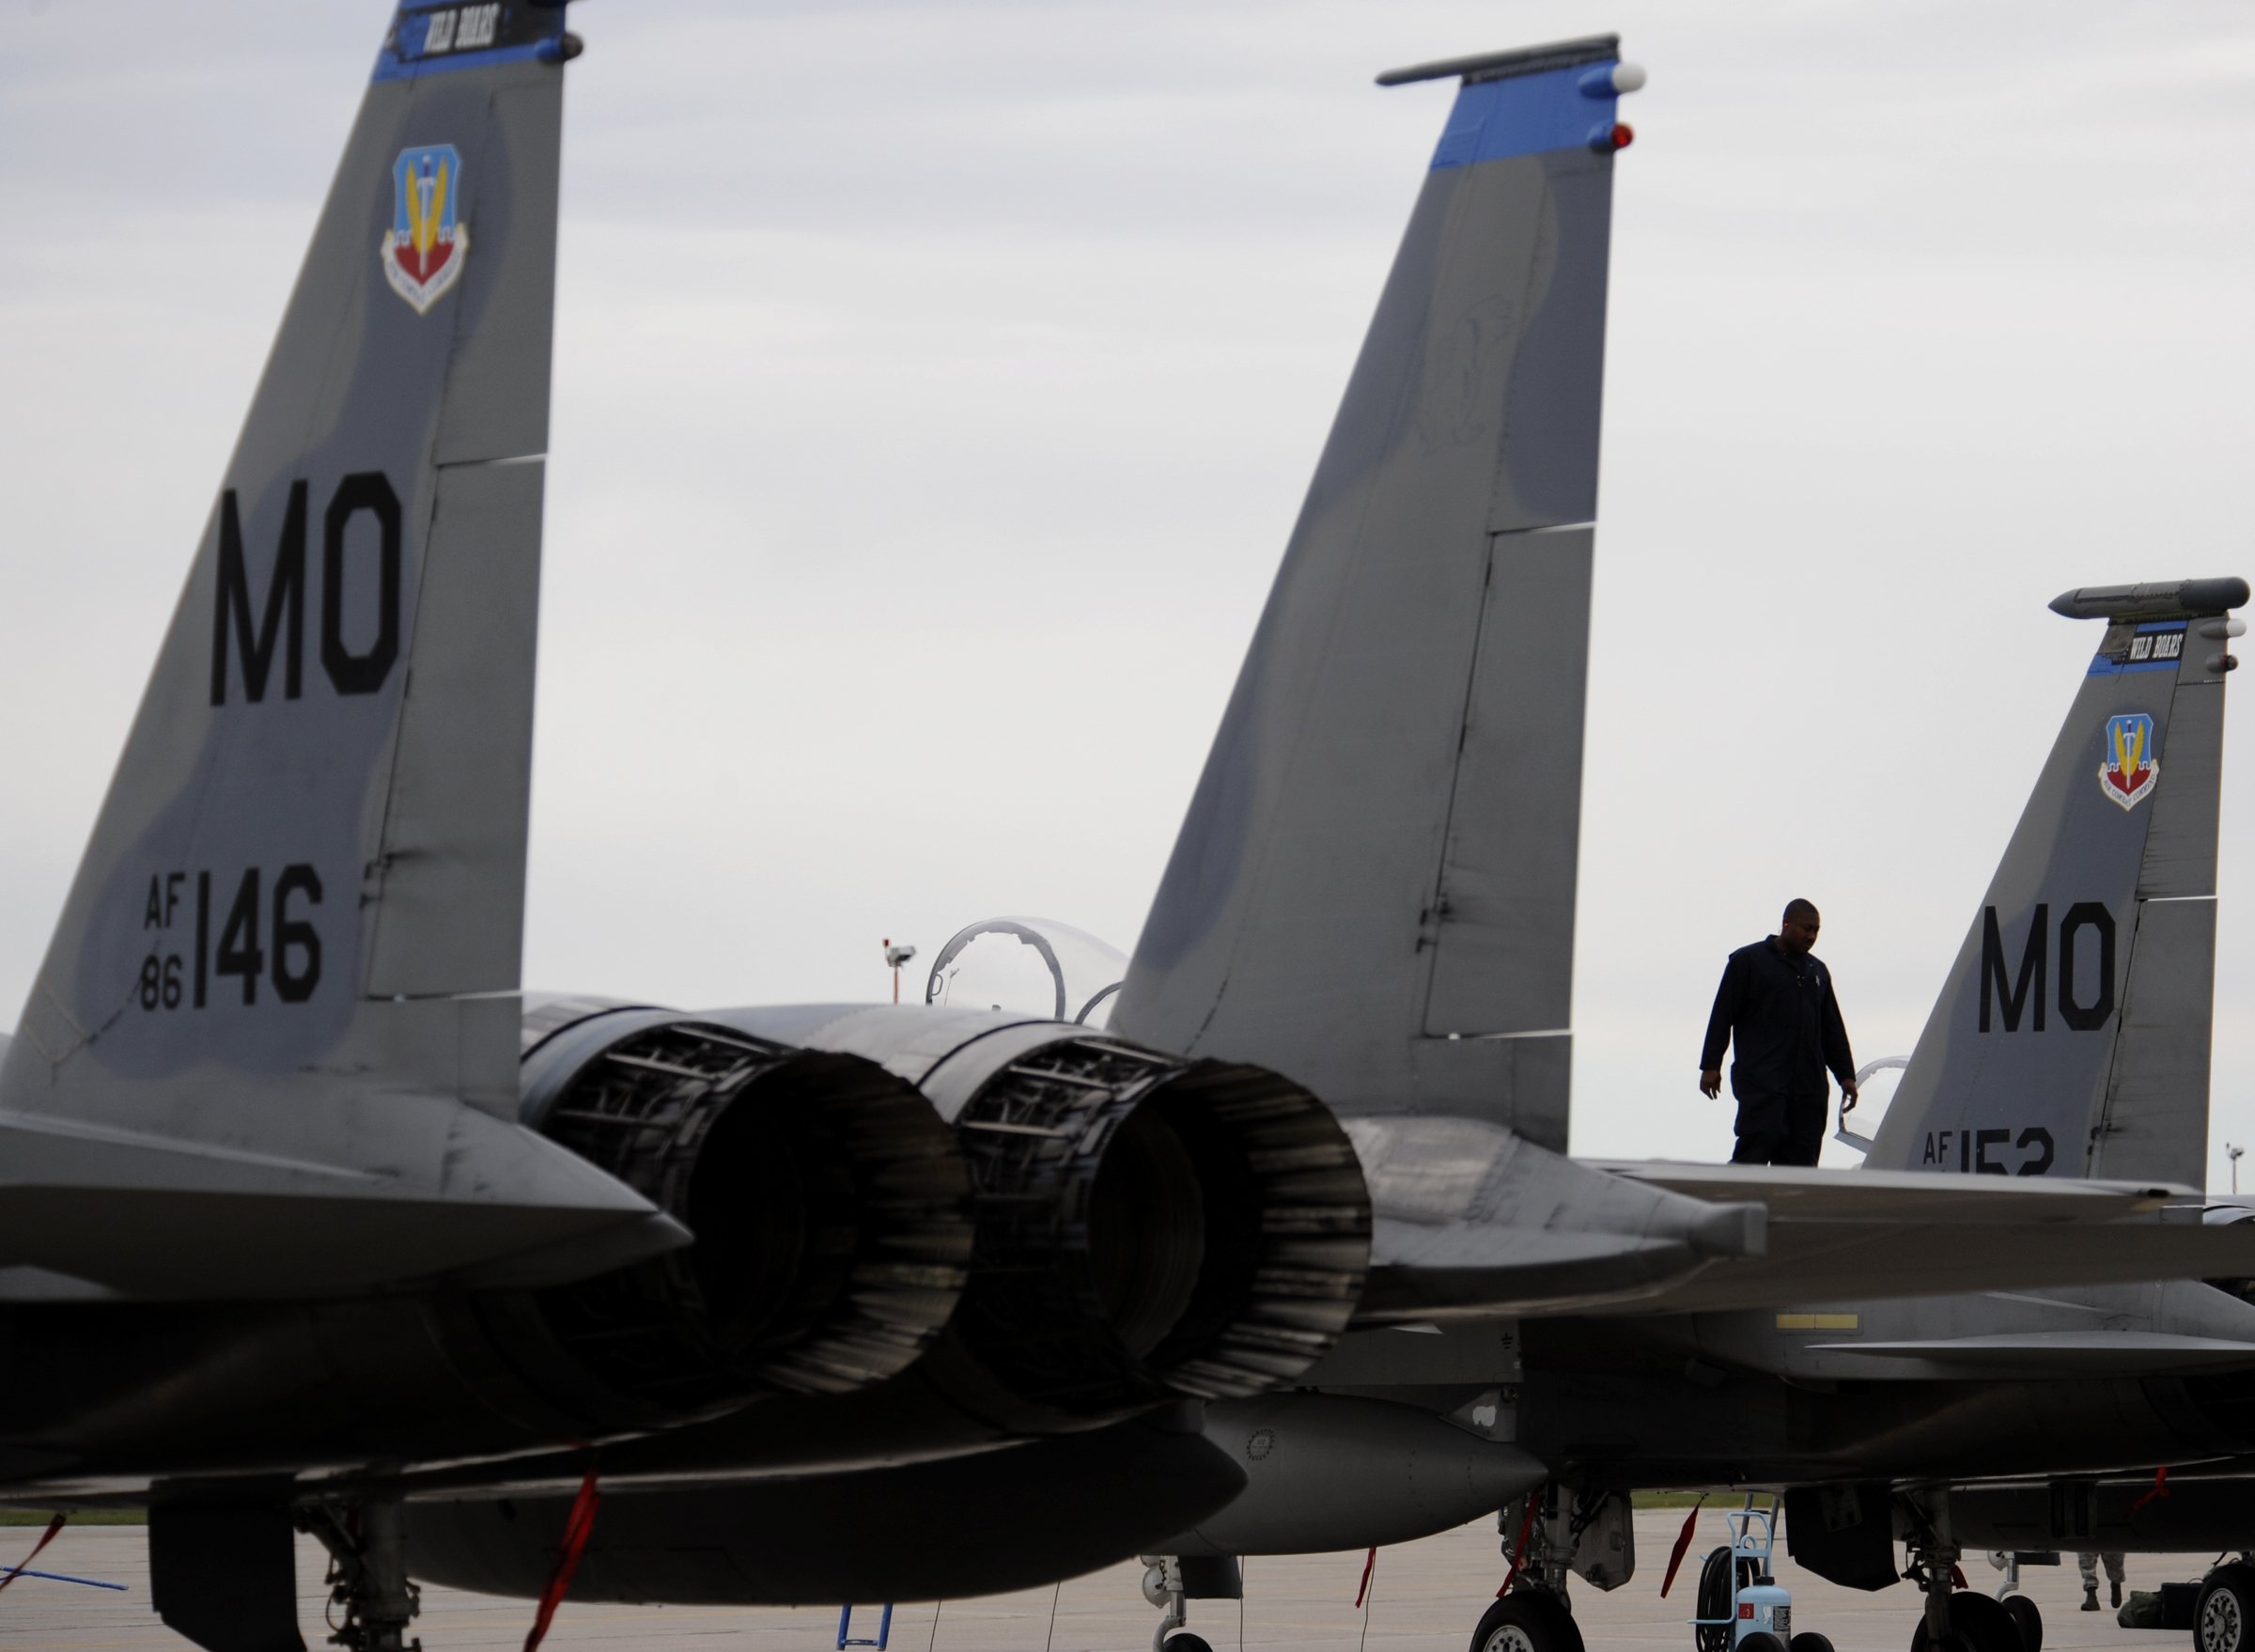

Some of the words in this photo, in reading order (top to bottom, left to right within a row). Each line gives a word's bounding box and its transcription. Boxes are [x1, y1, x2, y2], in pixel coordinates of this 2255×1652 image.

[210, 471, 401, 706] MO
[2129, 636, 2153, 660] WILD
[2152, 633, 2184, 659] BOARS
[144, 871, 186, 929] AF
[194, 863, 322, 1009] 146
[141, 953, 182, 1012] 86
[1978, 901, 2116, 1034] MO
[1923, 1130, 1952, 1164] AF
